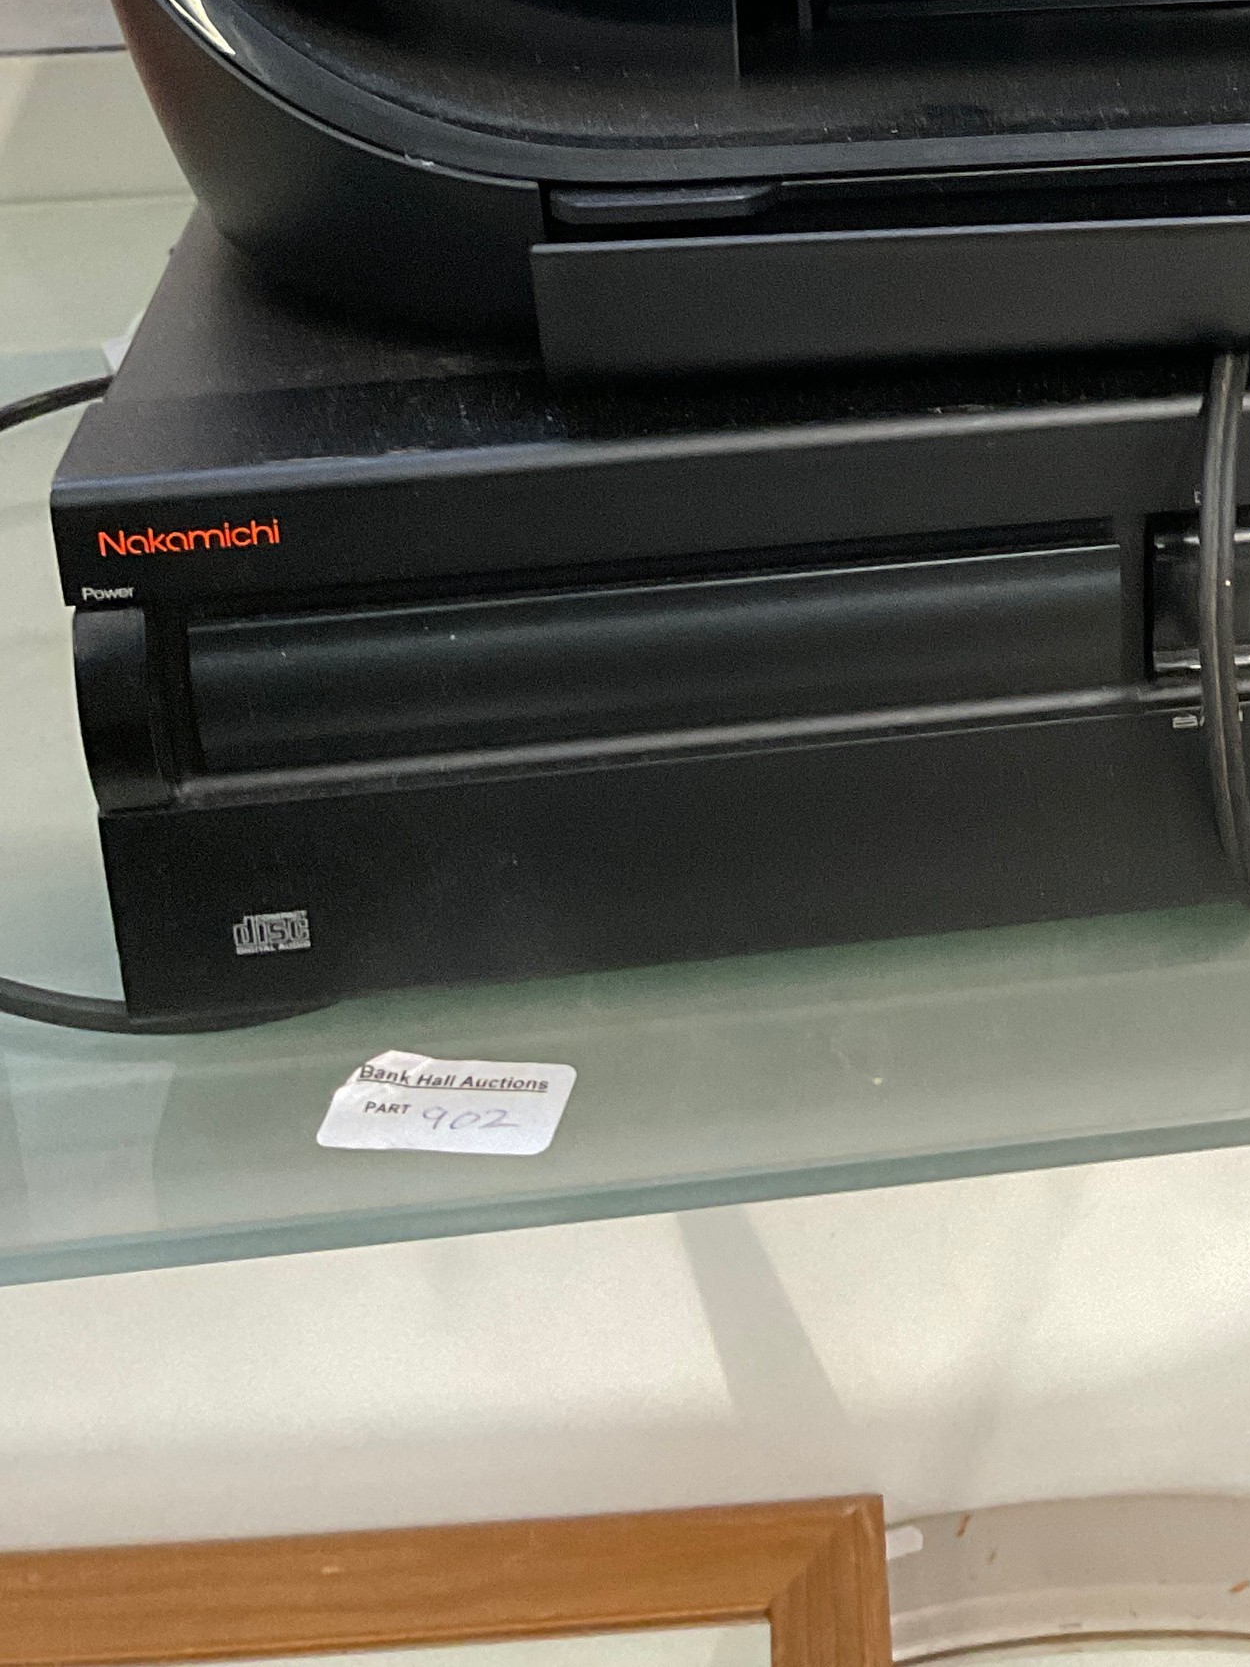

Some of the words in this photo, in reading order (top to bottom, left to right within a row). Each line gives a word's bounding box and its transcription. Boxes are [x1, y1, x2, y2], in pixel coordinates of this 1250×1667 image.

[98, 519, 280, 556] Nakamichi
[81, 587, 134, 601] Power
[360, 1065, 409, 1084] Bank
[416, 1074, 456, 1087] Hall
[458, 1075, 549, 1090] Auctions
[363, 1101, 412, 1114] PART
[422, 1106, 520, 1130] 902
